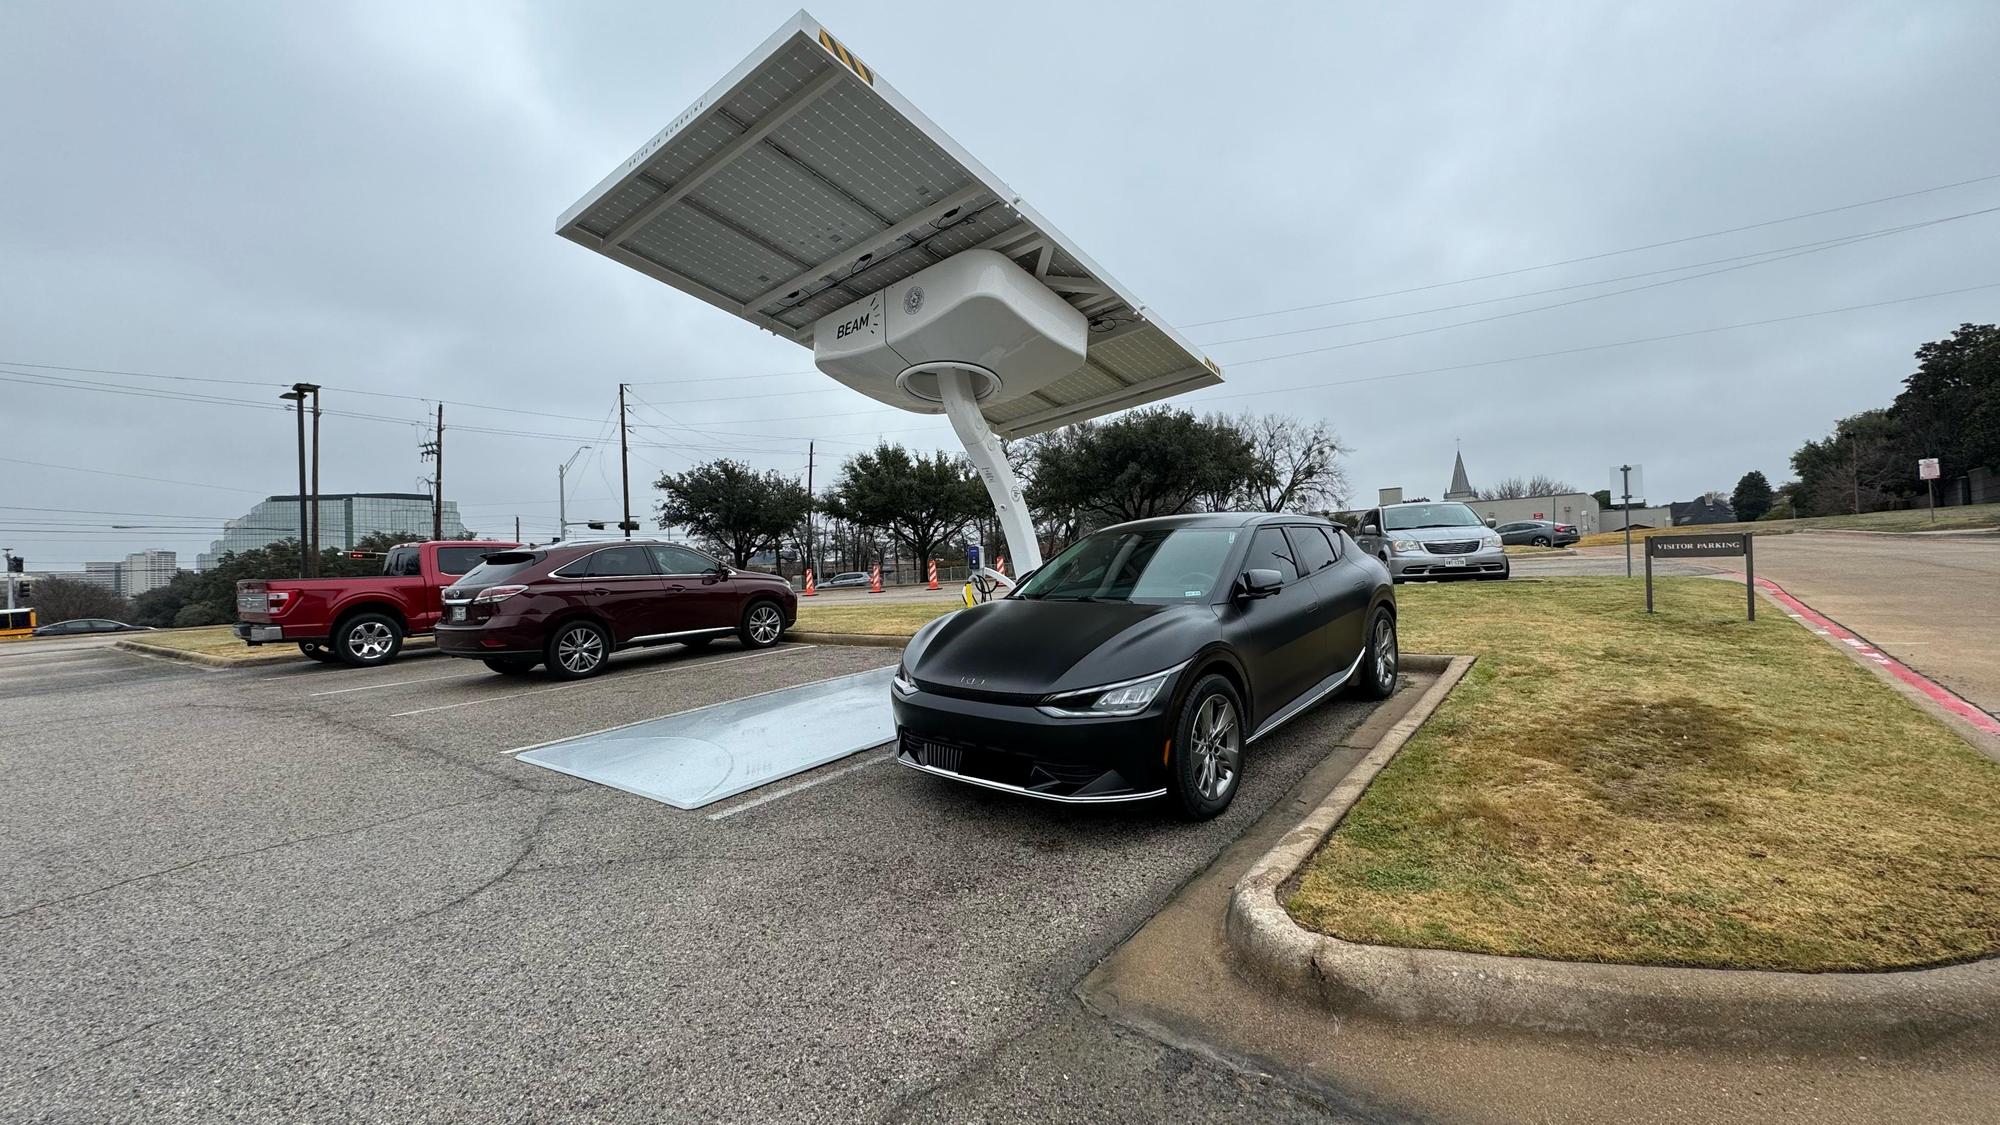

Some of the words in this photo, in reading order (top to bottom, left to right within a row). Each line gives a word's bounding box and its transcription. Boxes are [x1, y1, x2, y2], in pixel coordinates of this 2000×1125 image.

[628, 148, 648, 168] DRIVE
[652, 137, 661, 148] ON
[665, 101, 703, 137] SUNSHINE
[836, 312, 870, 340] BEAM
[1697, 541, 1740, 549] PARKING
